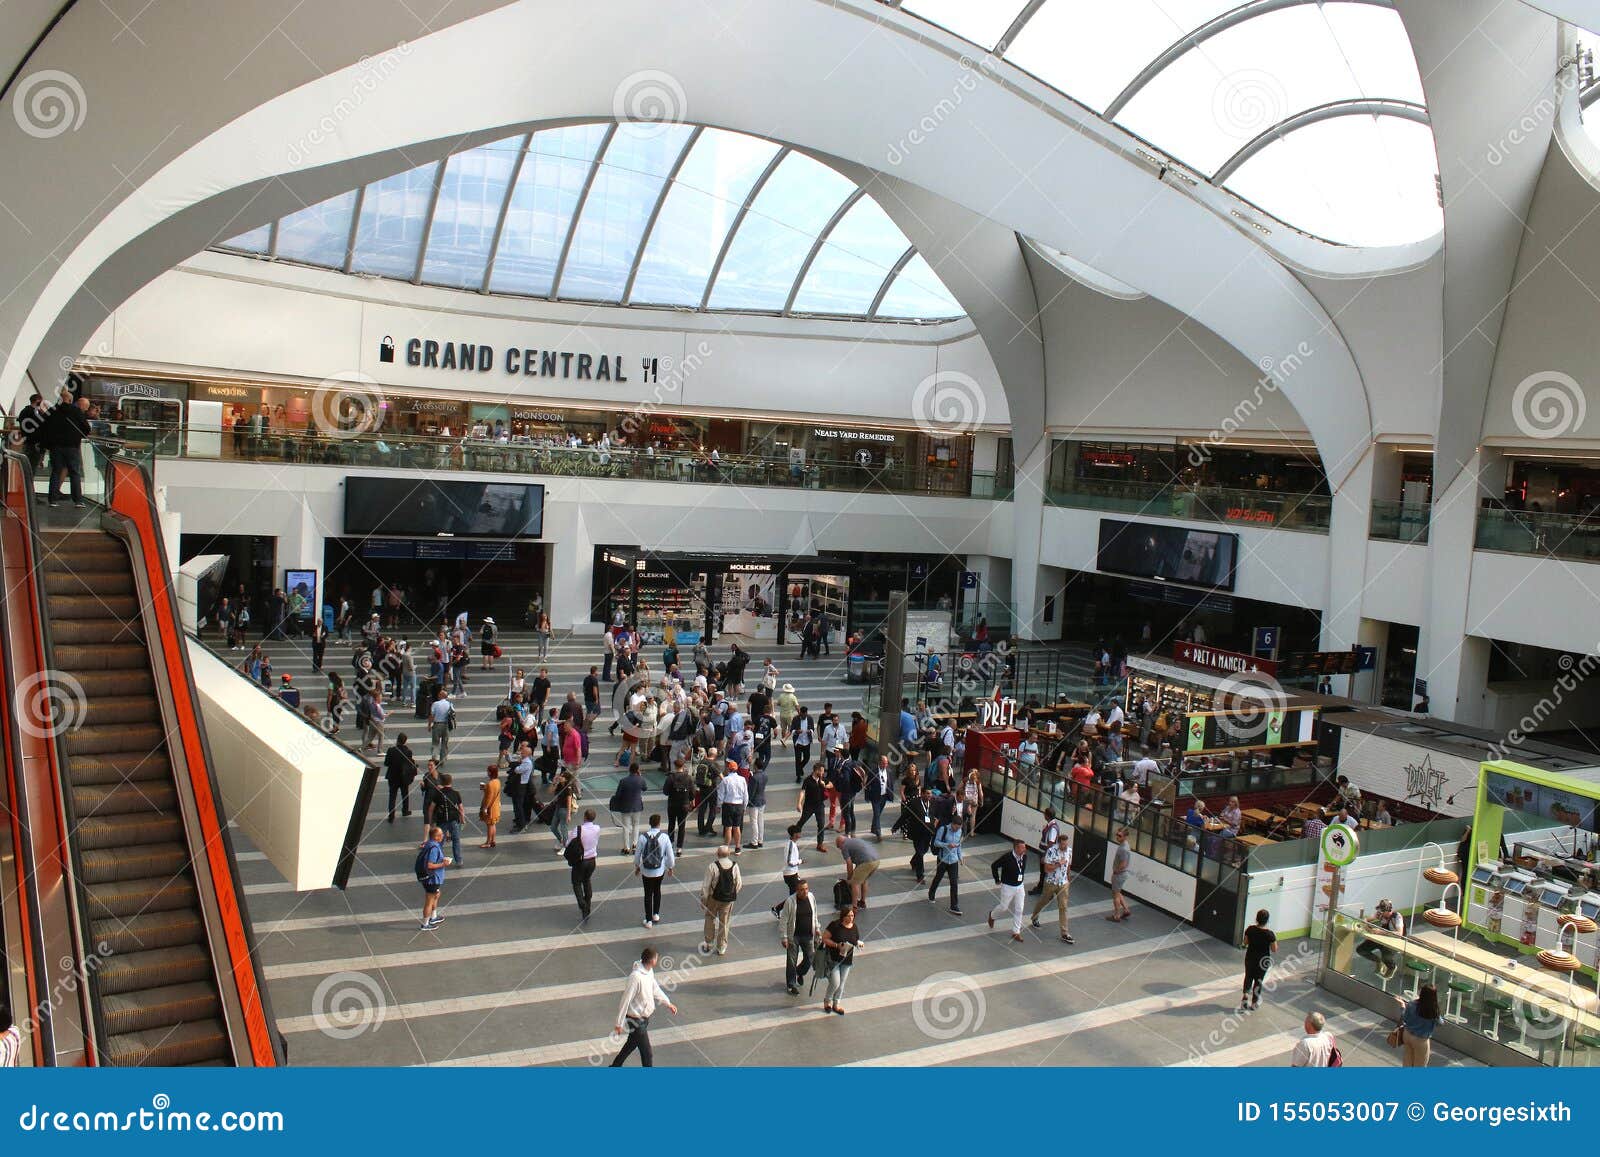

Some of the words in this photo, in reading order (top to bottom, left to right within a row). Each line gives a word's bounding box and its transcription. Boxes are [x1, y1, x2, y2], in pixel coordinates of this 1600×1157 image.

[407, 338, 493, 372] GRAND
[506, 348, 628, 382] CENTRAL
[514, 411, 565, 422] MONSOON
[839, 431, 859, 440] YARD
[859, 432, 896, 442] REMEDIES
[915, 565, 921, 575] 4
[967, 575, 973, 585] 5
[1264, 632, 1272, 645] 6
[1193, 648, 1210, 665] PRET
[1211, 653, 1217, 667] A
[1218, 655, 1247, 673] MANGER
[1364, 652, 1372, 665] 7
[983, 699, 1017, 727] PRET
[1407, 763, 1445, 800] PRET
